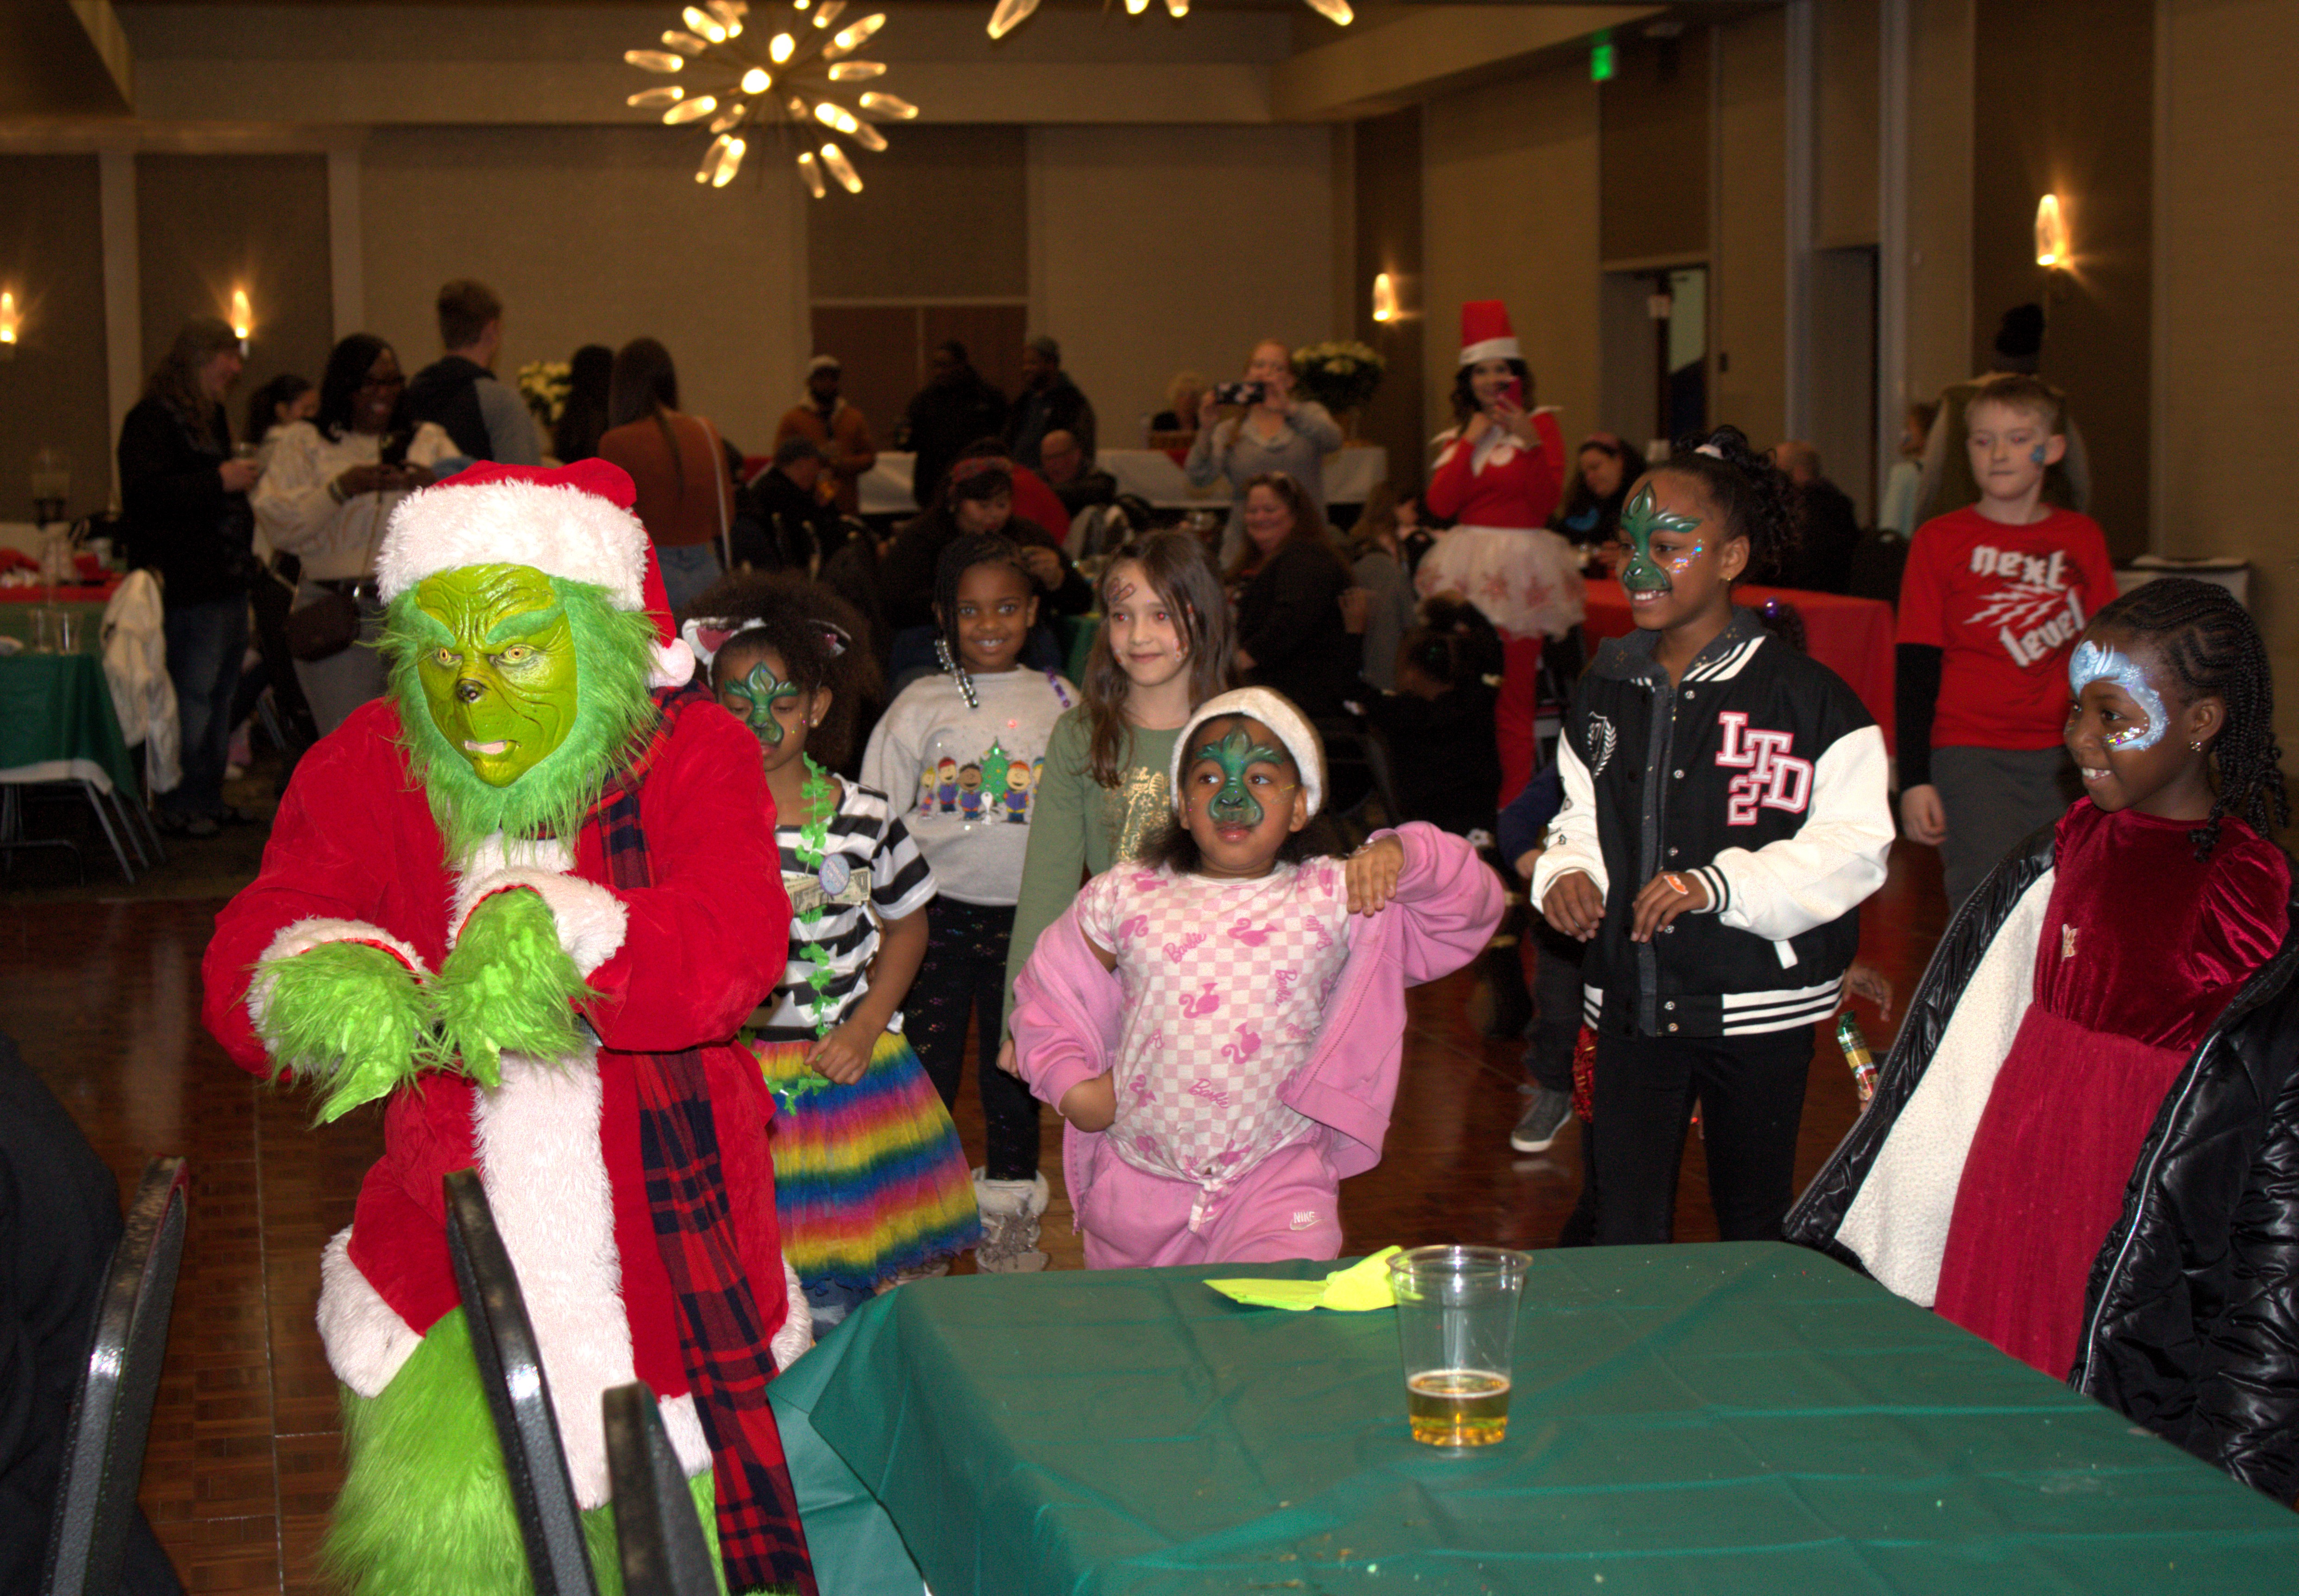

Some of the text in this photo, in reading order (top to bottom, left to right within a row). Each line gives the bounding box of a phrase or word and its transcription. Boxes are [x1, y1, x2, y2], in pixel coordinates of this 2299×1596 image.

[1969, 544, 2068, 591] next
[1998, 587, 2084, 668] level
[1715, 711, 1814, 814] LTD
[1727, 775, 1760, 826] 2
[1162, 932, 1207, 964] Barbie
[1275, 969, 1298, 1007] Barbie
[1188, 1078, 1229, 1109] Barbie
[1294, 1211, 1315, 1224] NIKE
